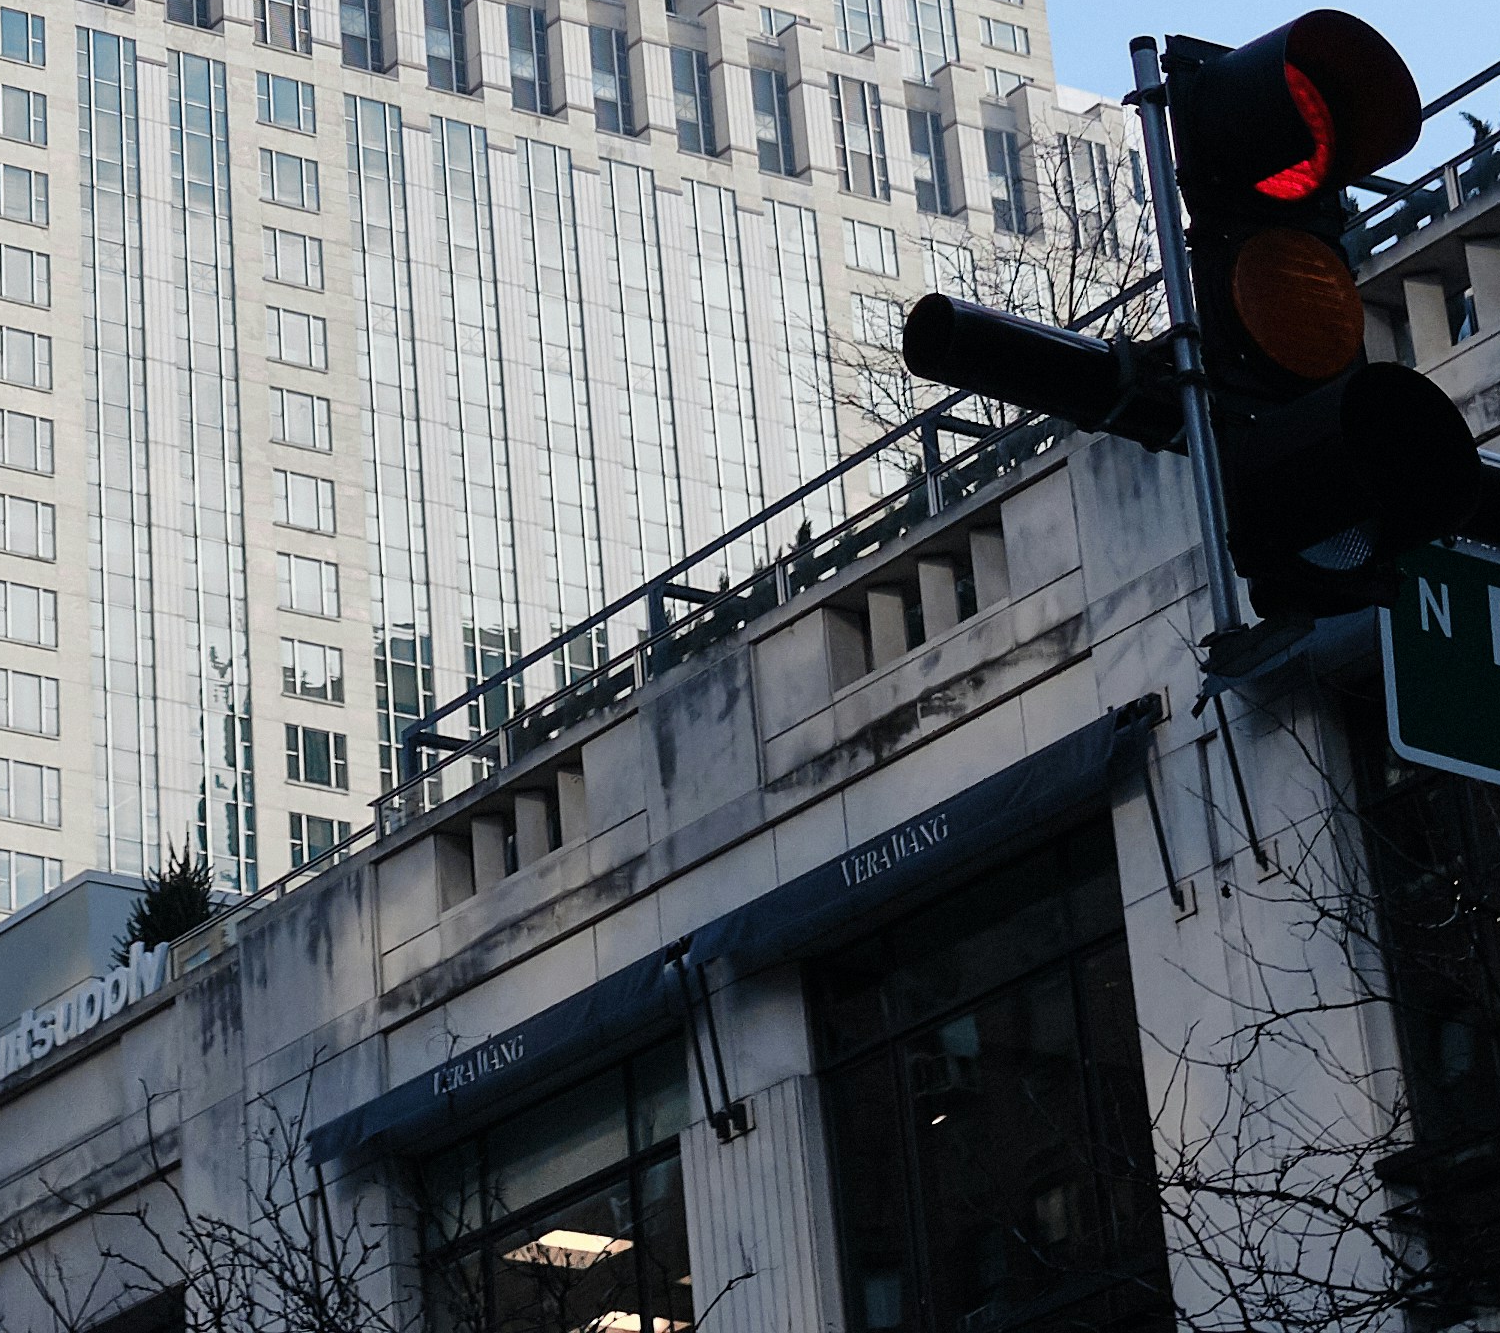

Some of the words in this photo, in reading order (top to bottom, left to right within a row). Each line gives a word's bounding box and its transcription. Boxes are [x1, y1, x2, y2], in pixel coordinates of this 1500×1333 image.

[1418, 576, 1452, 638] N
[840, 846, 891, 887] VERA
[889, 813, 949, 862] WANG
[475, 1034, 525, 1077] WANG
